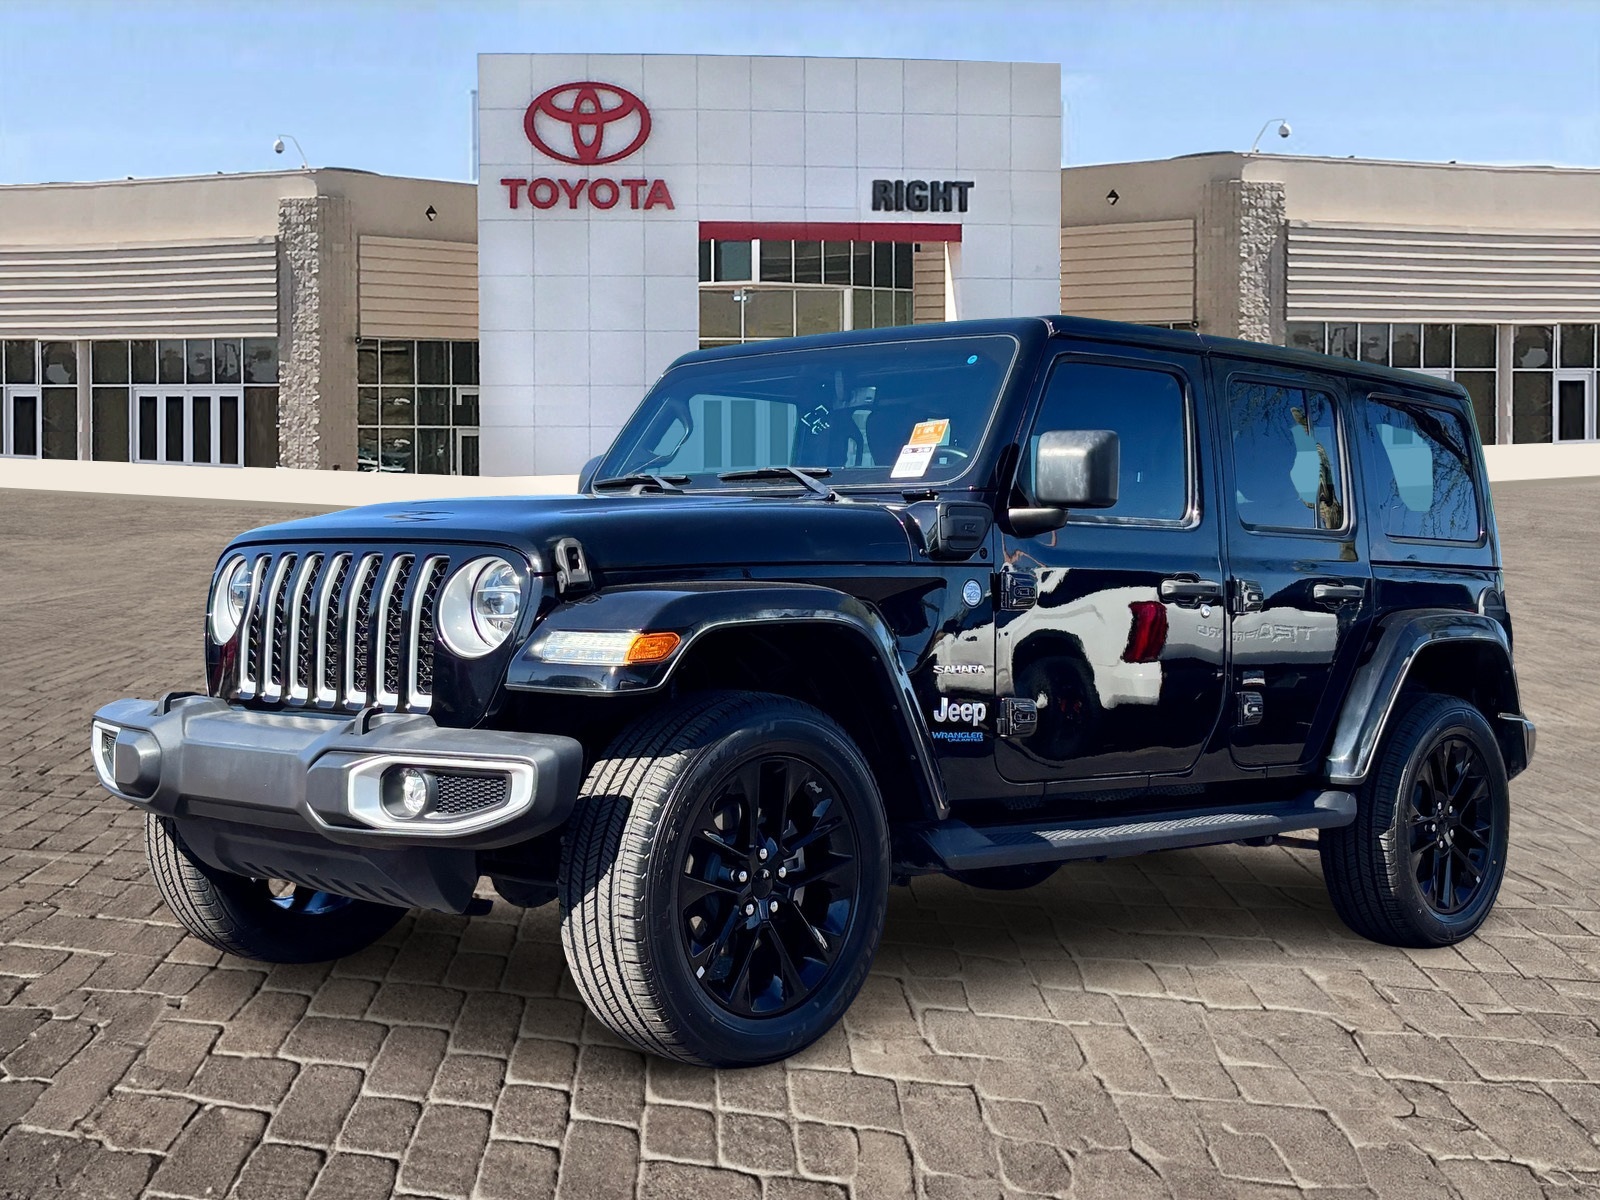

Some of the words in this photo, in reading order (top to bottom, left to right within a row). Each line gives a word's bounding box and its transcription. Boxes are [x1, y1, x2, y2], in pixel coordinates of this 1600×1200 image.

[500, 178, 675, 210] TOYOTA
[871, 179, 975, 213] RIGHT
[933, 665, 986, 674] SAHARA
[933, 697, 986, 726] Jeep
[931, 731, 983, 739] WRANGLER
